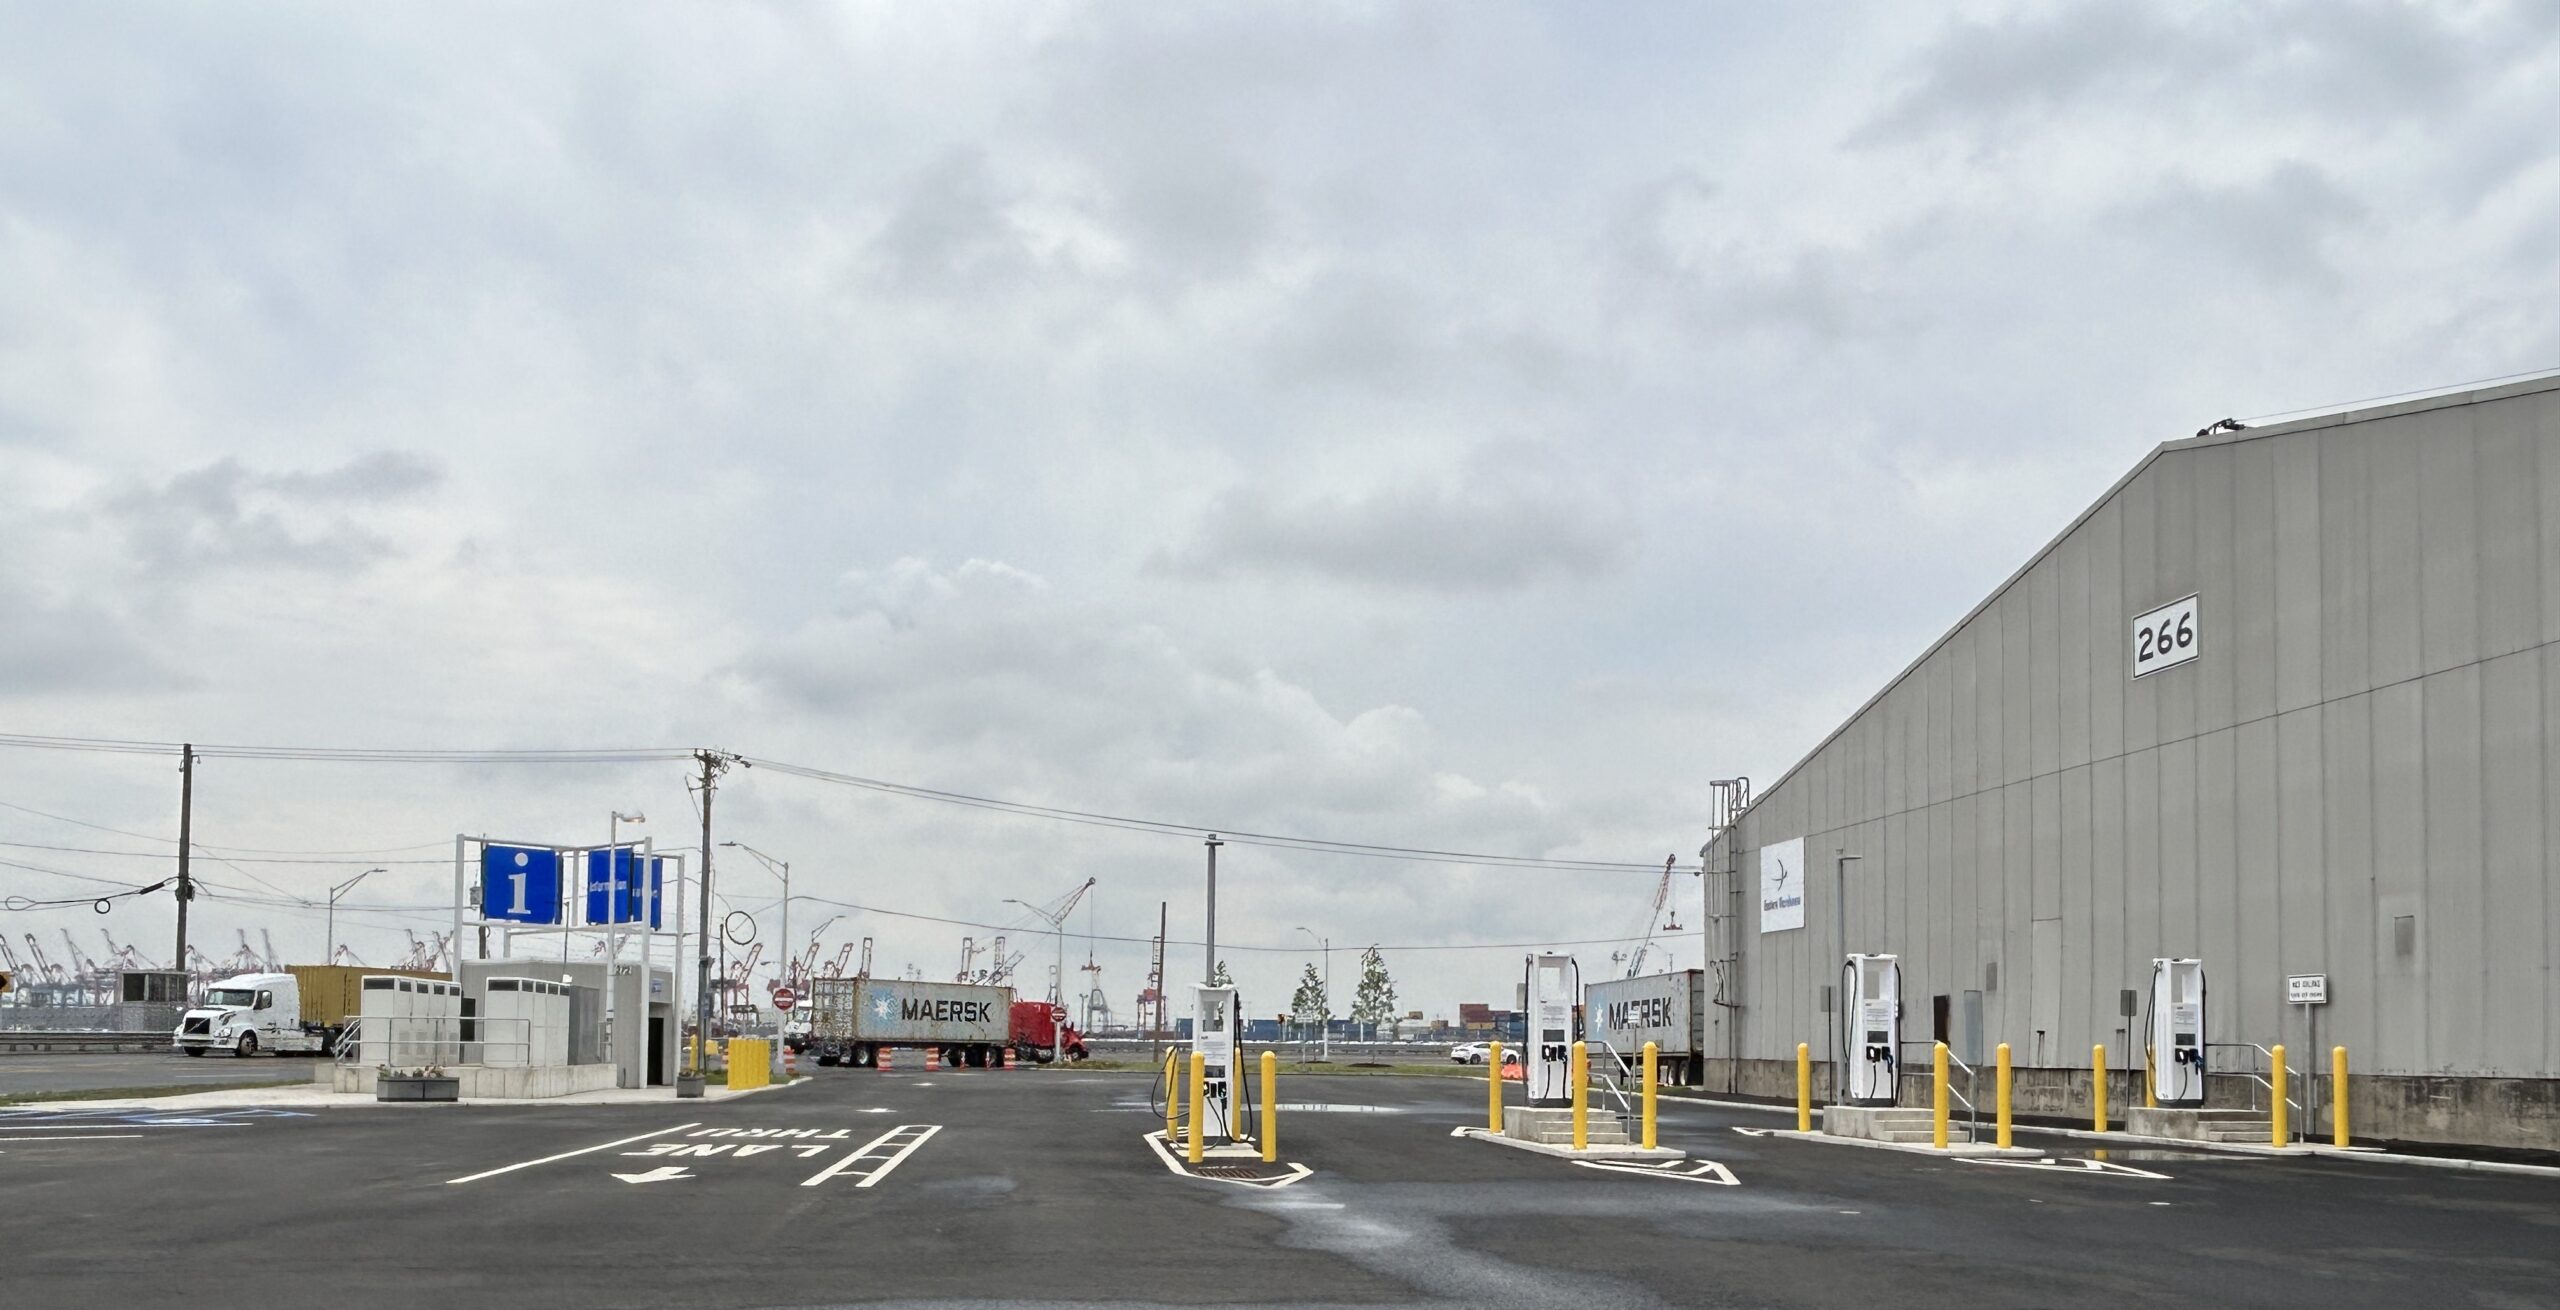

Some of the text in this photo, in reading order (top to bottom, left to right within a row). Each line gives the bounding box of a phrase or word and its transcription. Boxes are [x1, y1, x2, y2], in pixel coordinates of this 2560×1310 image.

[2139, 611, 2193, 663] 266
[902, 998, 991, 1023] MAERSK
[686, 1128, 852, 1138] THRU
[620, 1143, 830, 1158] LANE
